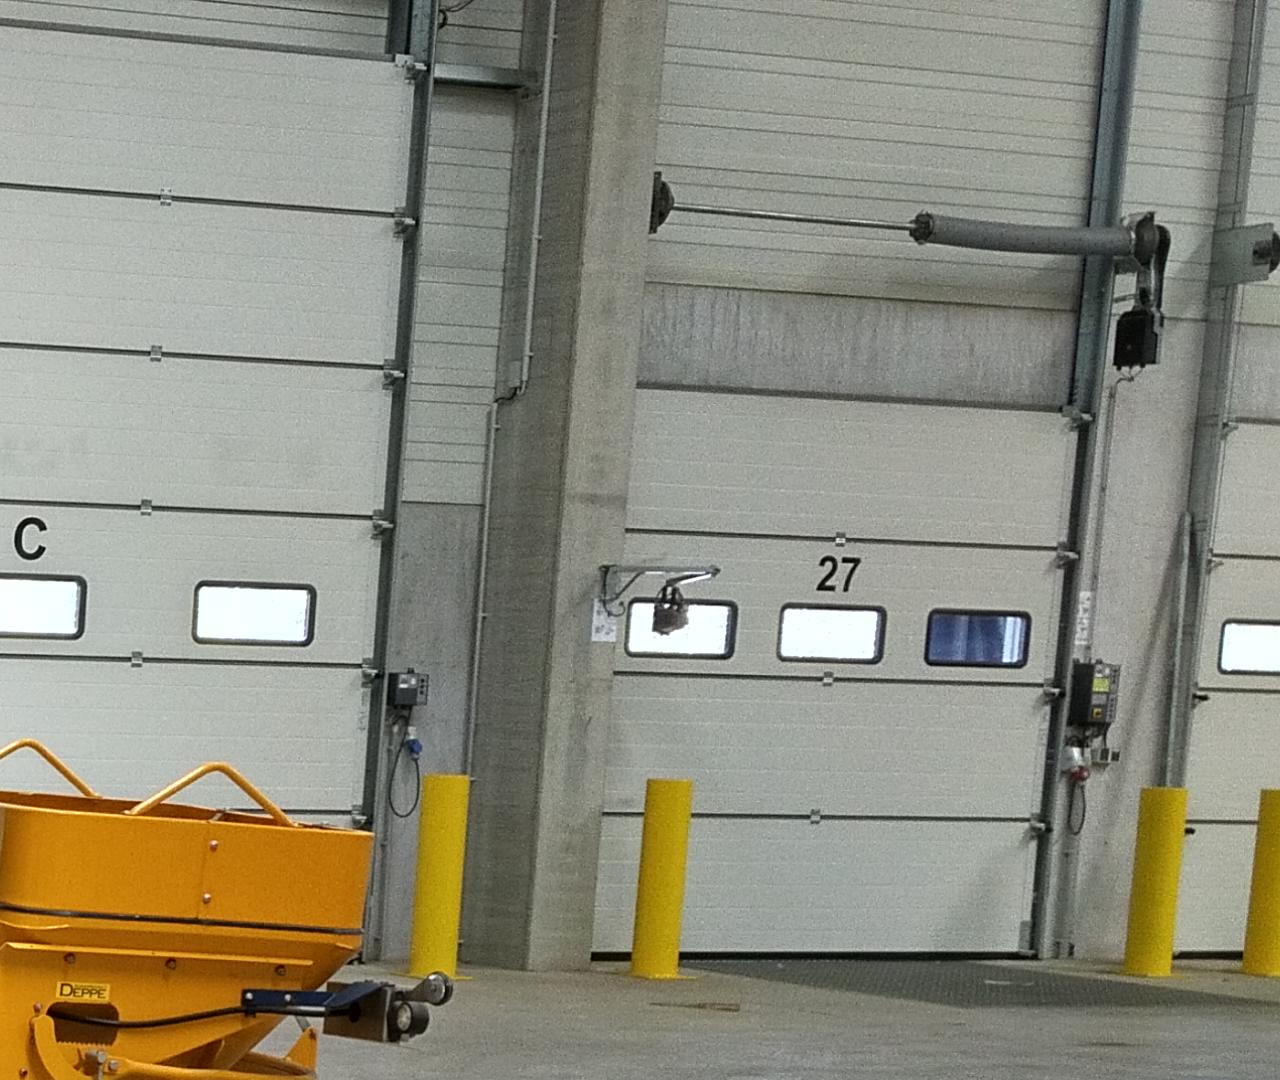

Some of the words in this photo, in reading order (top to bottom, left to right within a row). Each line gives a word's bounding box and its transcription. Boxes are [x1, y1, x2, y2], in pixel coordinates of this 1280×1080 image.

[13, 516, 48, 561] C
[815, 554, 862, 593] 27
[59, 982, 107, 999] DEPPE
